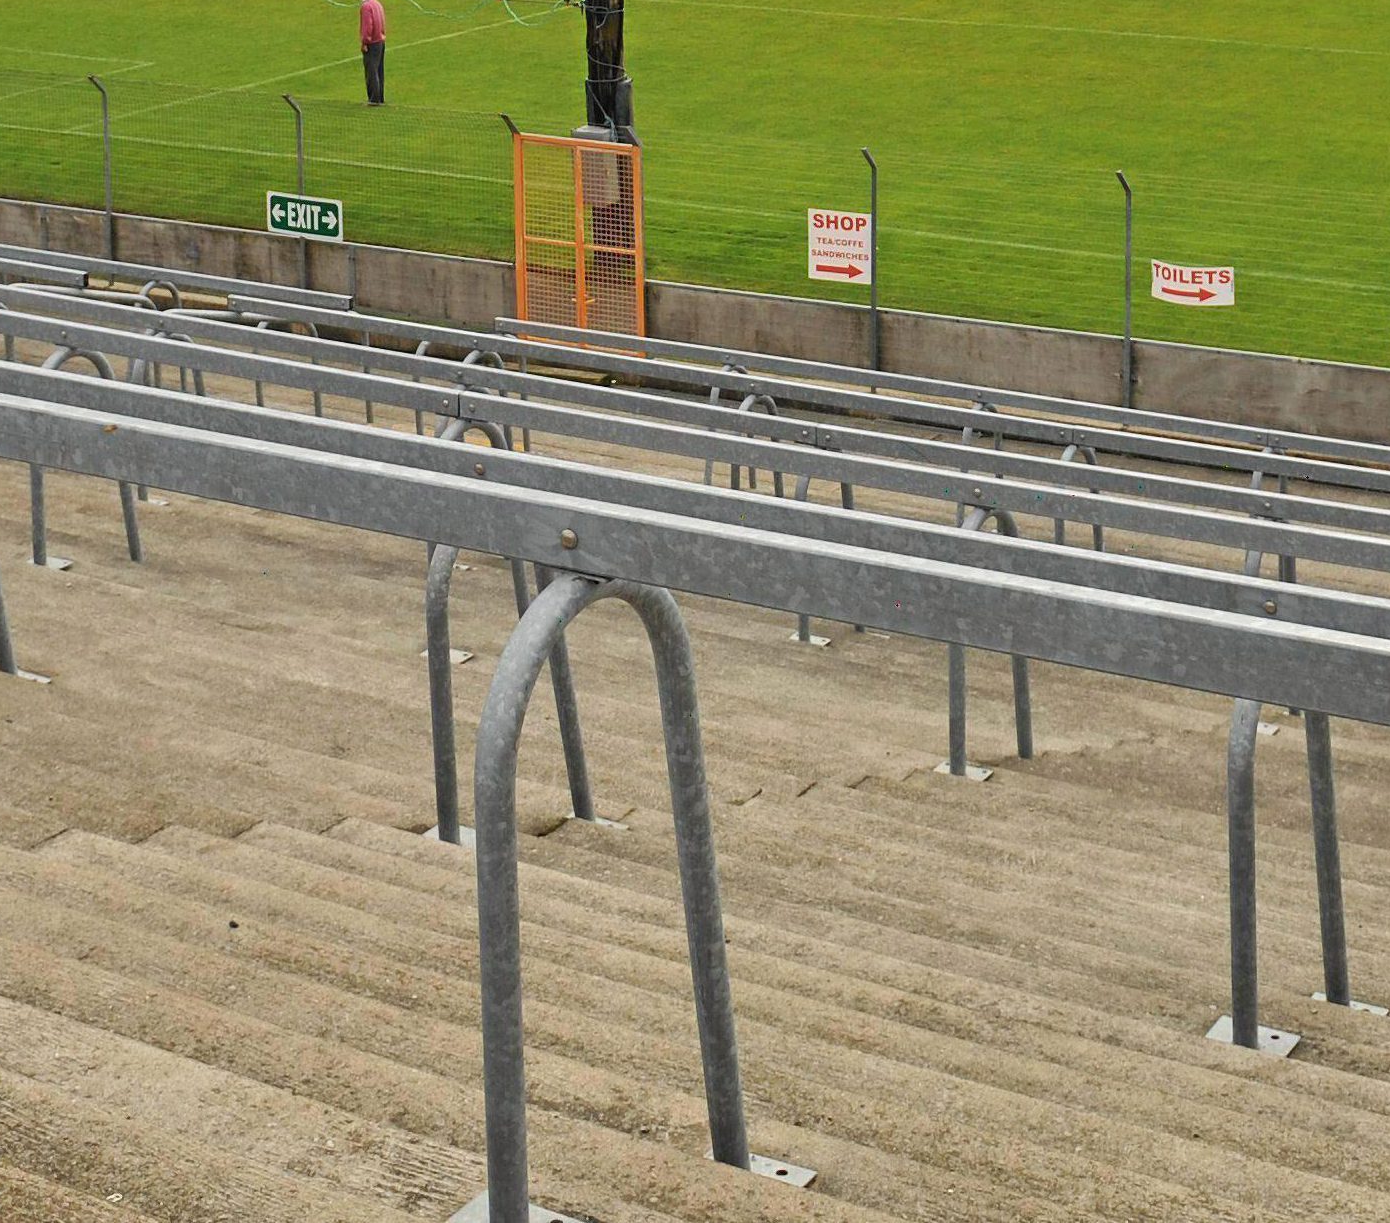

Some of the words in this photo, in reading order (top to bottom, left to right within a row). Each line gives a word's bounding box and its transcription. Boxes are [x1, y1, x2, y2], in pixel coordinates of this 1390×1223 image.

[287, 201, 321, 231] EXIT
[813, 214, 867, 232] SHOP
[811, 249, 870, 261] SANDWICHES
[1153, 263, 1231, 284] TOILETS
